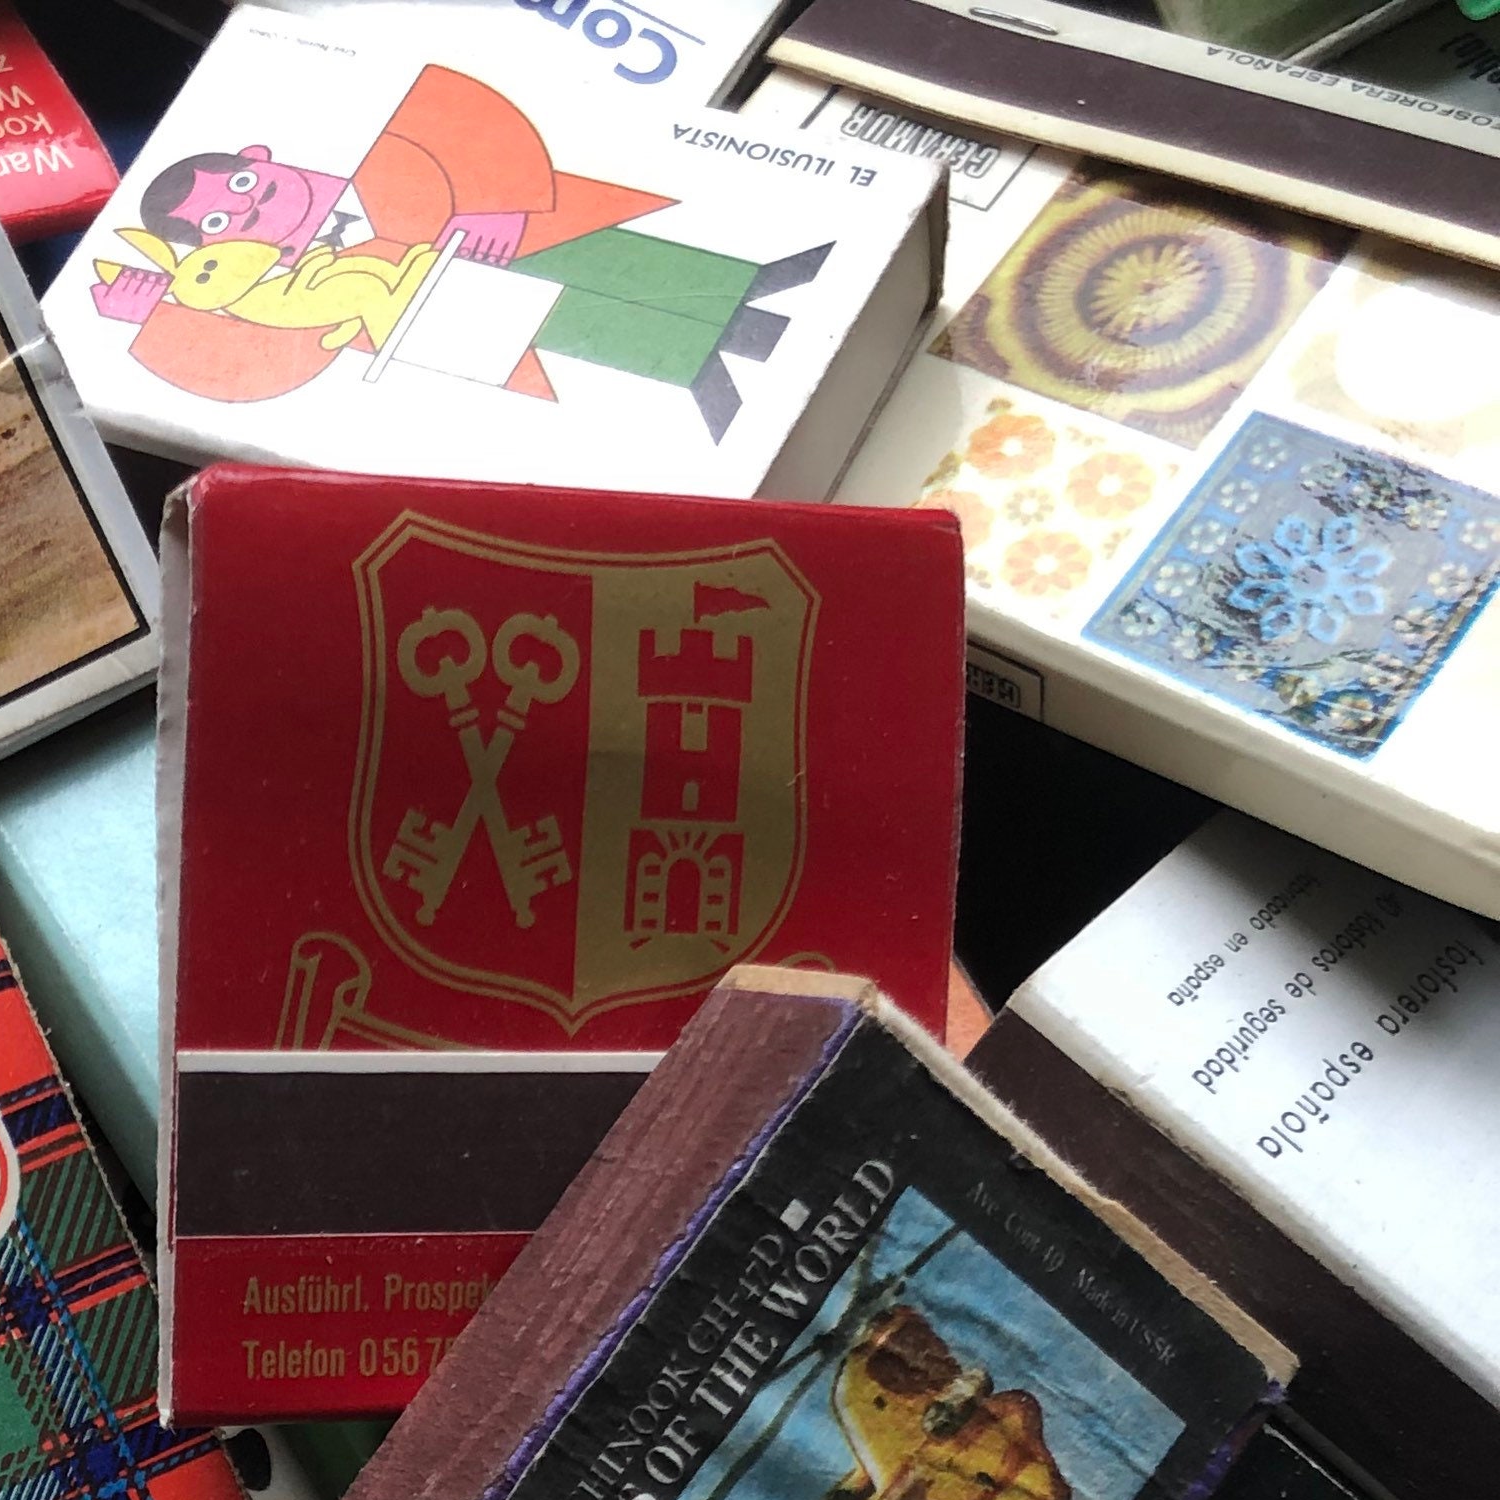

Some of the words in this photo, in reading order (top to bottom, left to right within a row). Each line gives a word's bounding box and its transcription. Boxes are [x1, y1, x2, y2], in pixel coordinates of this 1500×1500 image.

[1206, 45, 1341, 87] ESPAÑOLA
[671, 121, 834, 178] ILUSIONISTA
[850, 163, 878, 188] EL
[1225, 931, 1250, 954] en
[1167, 953, 1226, 1007] españa
[1285, 971, 1318, 997] de
[1191, 998, 1288, 1095] seguridad
[1256, 1040, 1375, 1159] española
[243, 1275, 369, 1315] Ausführl.
[1068, 1267, 1121, 1315] Made
[1109, 1306, 1132, 1329] in
[644, 1414, 701, 1486] OF
[690, 1319, 779, 1418] THE
[760, 1158, 897, 1319] WORLD
[242, 1339, 346, 1379] Telefon
